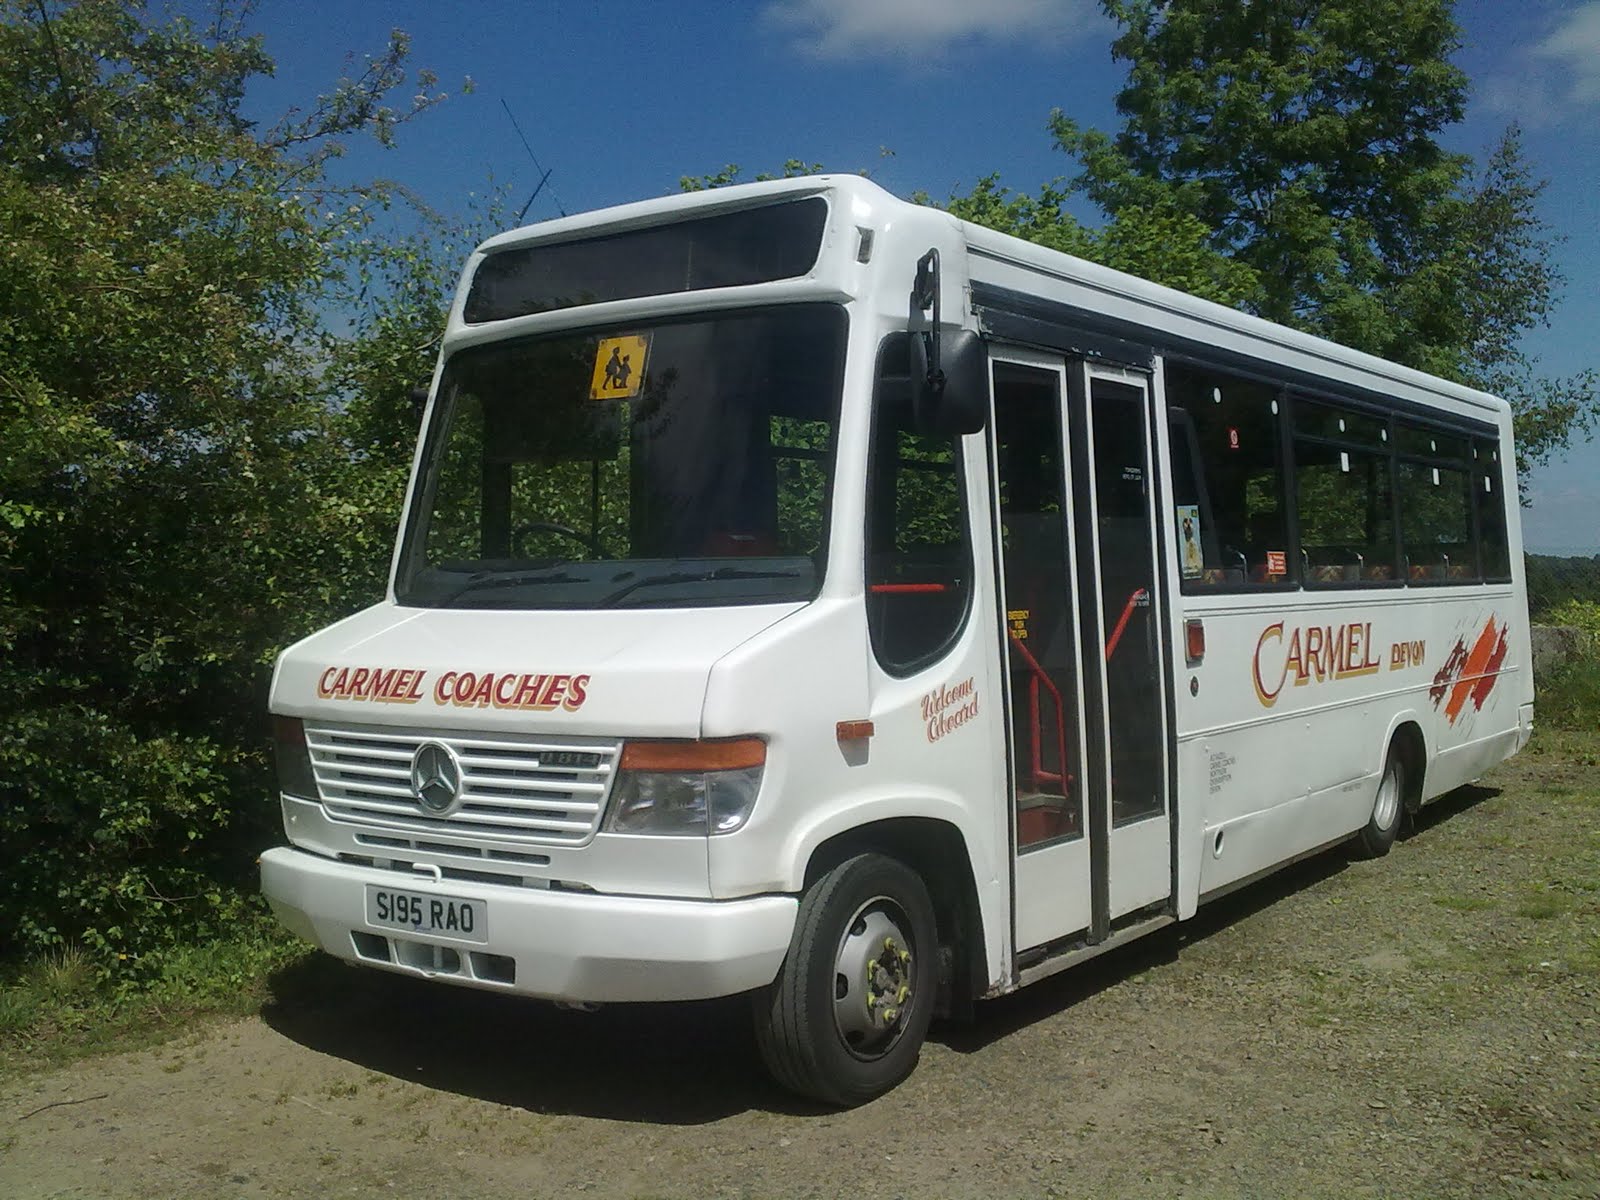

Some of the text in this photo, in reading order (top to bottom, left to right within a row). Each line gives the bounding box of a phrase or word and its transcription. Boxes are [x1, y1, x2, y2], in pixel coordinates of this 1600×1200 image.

[1252, 620, 1427, 708] CARMEL DEVON
[317, 666, 592, 713] CARMEL COACHES
[920, 676, 974, 721] Welcome
[376, 891, 474, 934] S195 RAO
